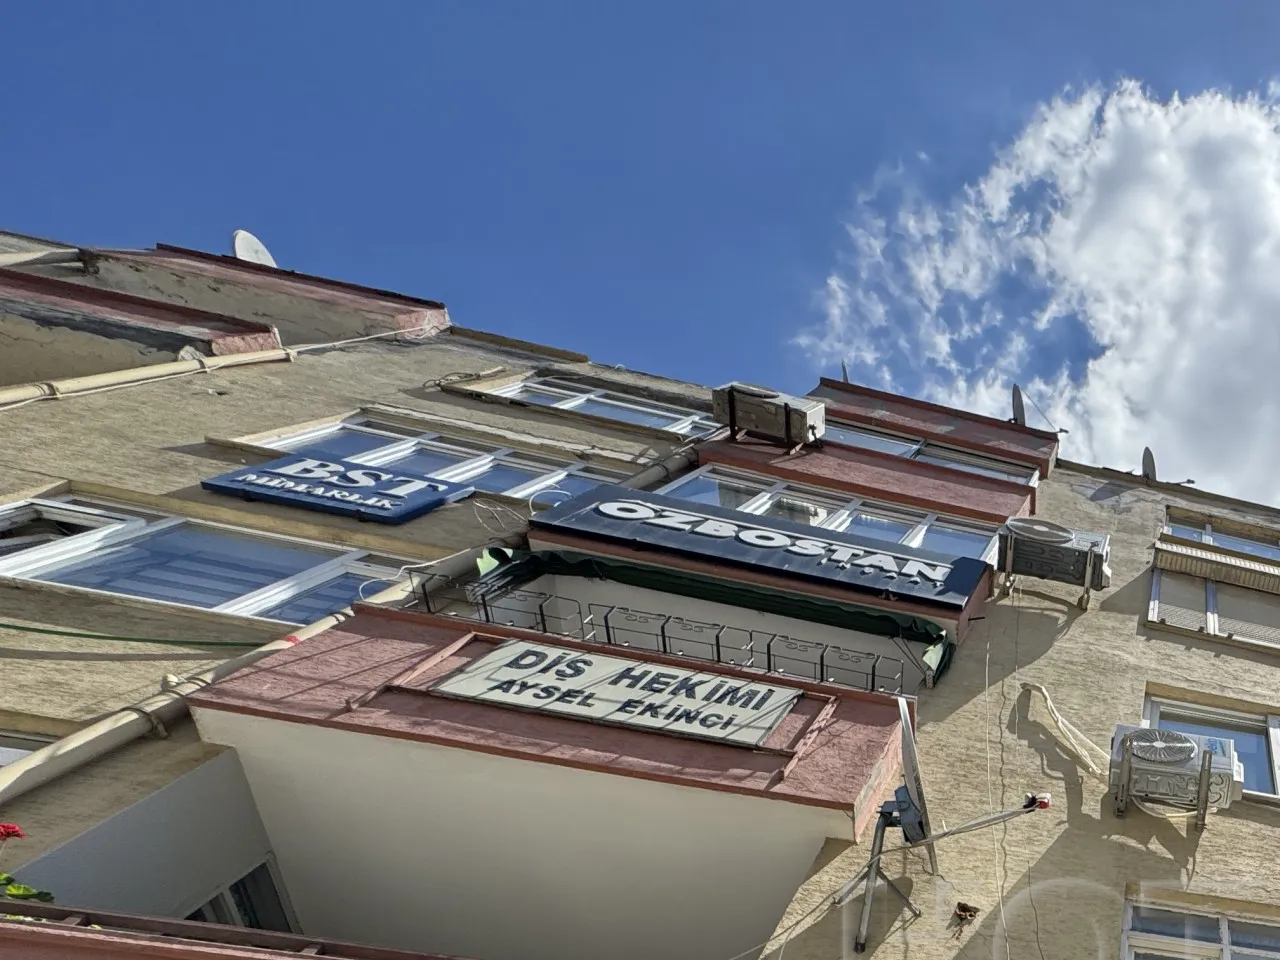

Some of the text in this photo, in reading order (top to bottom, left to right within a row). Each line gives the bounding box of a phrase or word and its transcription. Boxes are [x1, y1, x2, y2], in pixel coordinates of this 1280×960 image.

[263, 457, 448, 500] BST
[488, 678, 596, 708] AYSEL
[503, 649, 775, 711] DİŞ HEKİMİ
